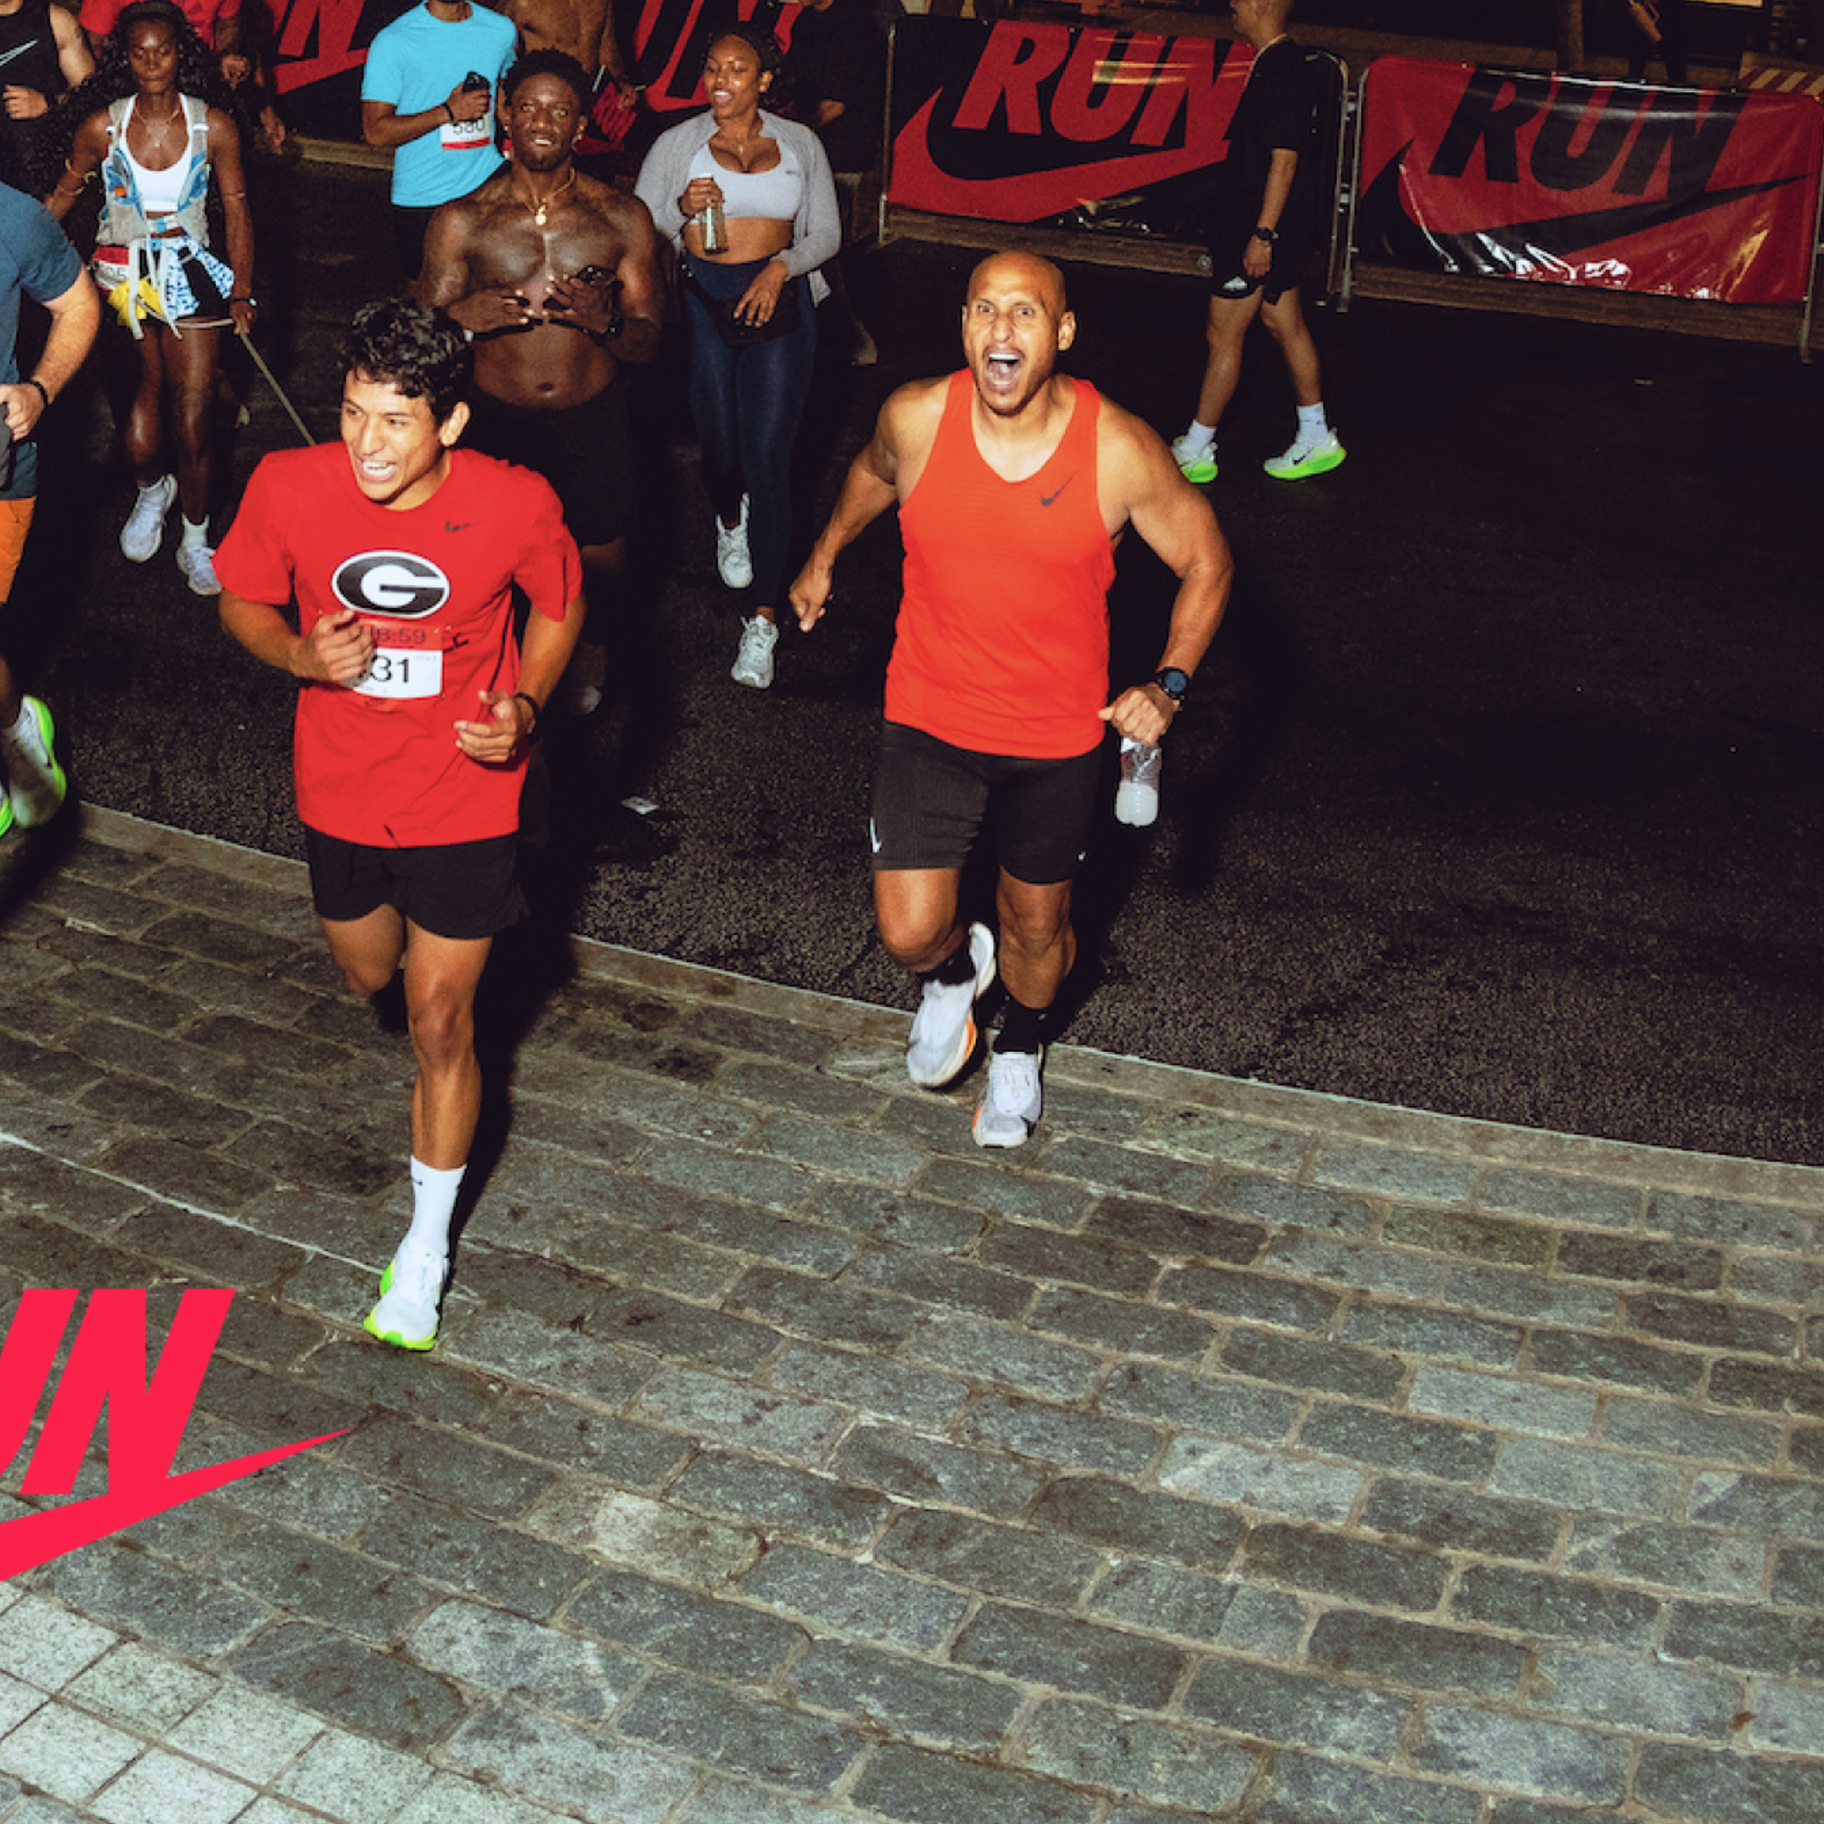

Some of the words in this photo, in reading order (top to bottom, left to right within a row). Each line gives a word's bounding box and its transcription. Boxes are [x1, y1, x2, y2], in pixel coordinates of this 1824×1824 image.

[951, 19, 1256, 149] RUN
[1428, 69, 1750, 197] RUN
[331, 551, 449, 618] G
[367, 655, 409, 684] 31
